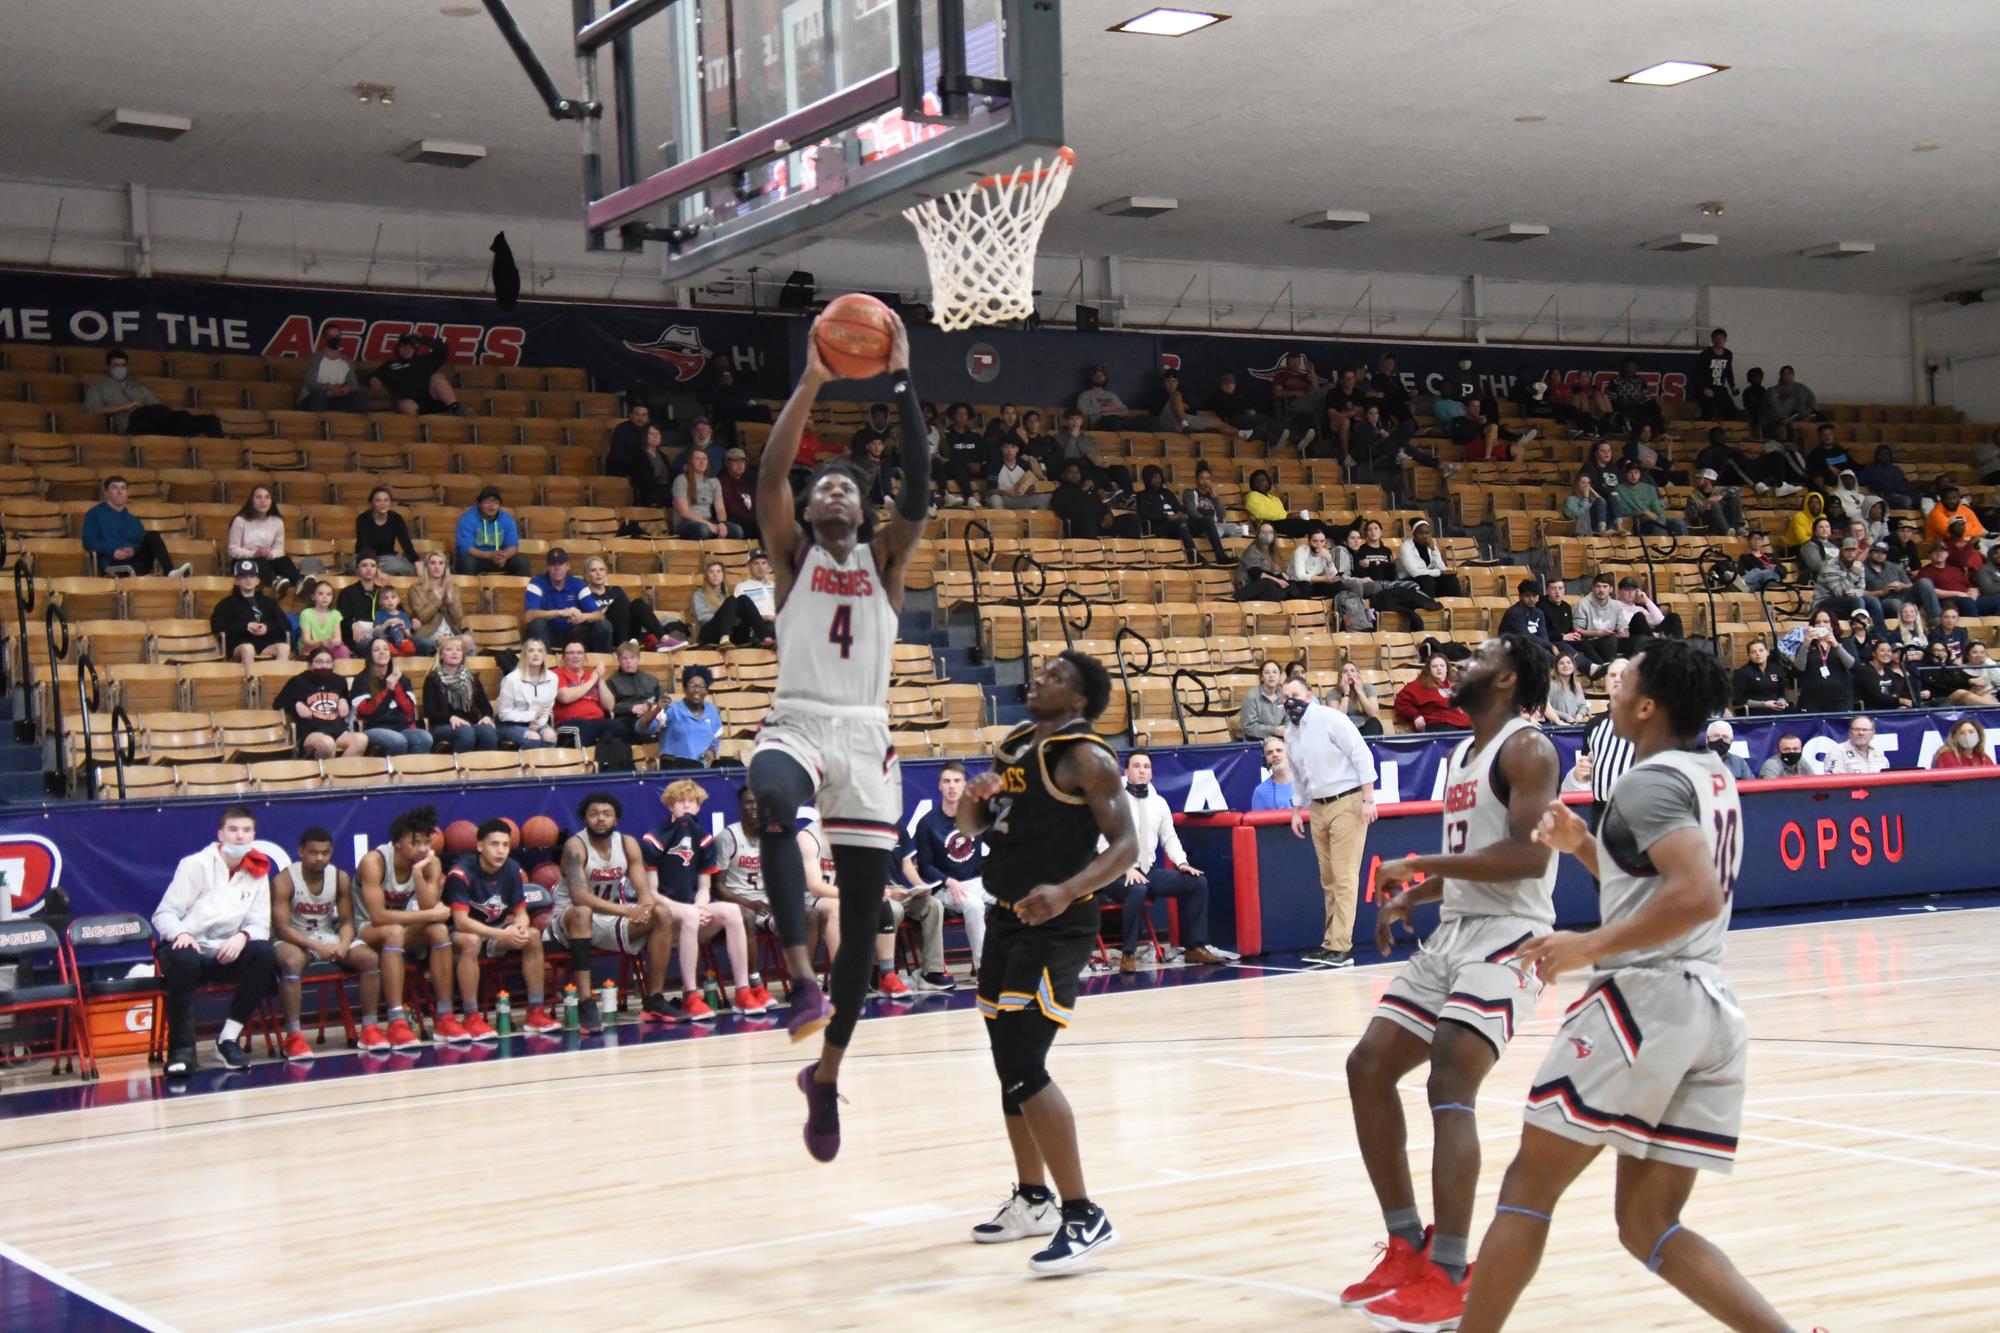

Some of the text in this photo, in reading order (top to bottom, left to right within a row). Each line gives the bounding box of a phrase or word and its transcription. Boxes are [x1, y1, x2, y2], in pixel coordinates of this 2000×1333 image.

[69, 310, 140, 342] OF
[156, 312, 250, 350] THE
[811, 565, 874, 598] AGGIES
[828, 603, 854, 660] 4
[1780, 815, 1903, 871] OPSU
[82, 921, 140, 939] AGGIES
